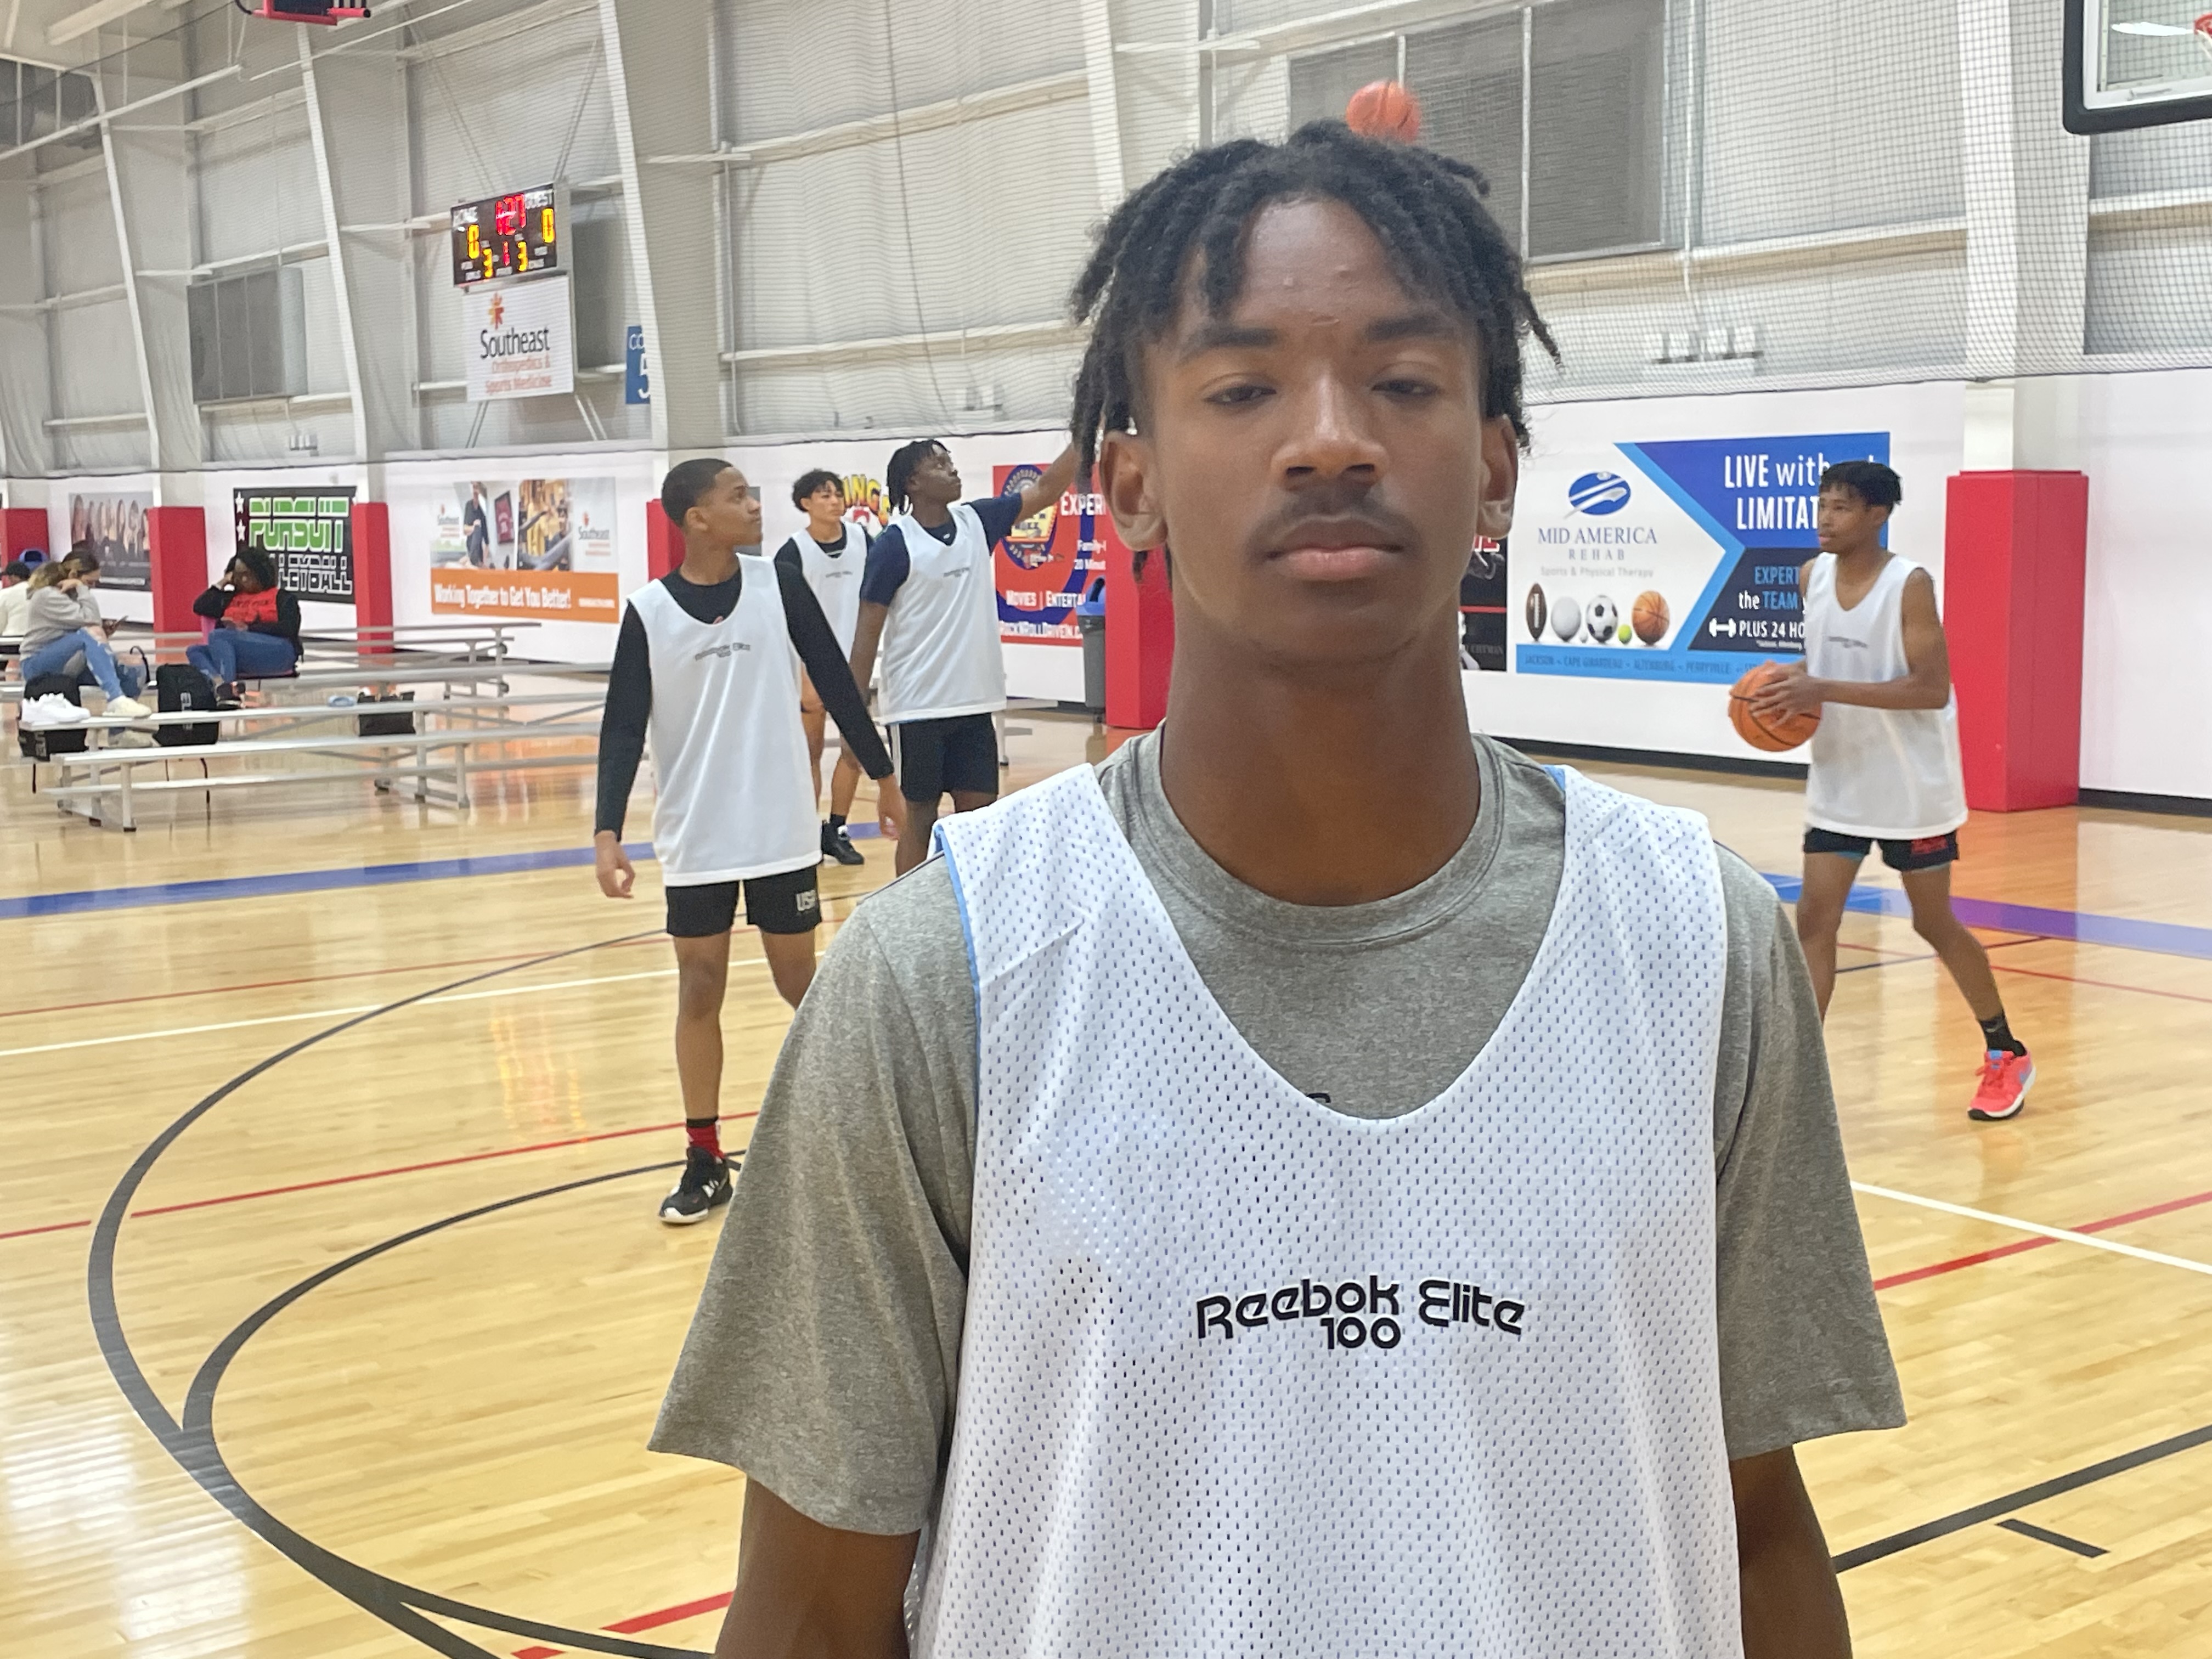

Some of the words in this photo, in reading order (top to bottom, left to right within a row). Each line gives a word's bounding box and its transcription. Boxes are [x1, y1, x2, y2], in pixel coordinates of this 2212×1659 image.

[480, 328, 550, 359] Southeast
[1724, 454, 1769, 488] LIVE
[1736, 495, 1820, 530] LIMITAT
[1538, 527, 1571, 545] MID
[1575, 526, 1657, 545] AMERICA
[1568, 548, 1625, 561] REHAB
[1754, 566, 1801, 585] EXPERT
[1739, 590, 1760, 610] the
[1763, 590, 1798, 611] TEAM
[1738, 620, 1768, 638] PLUS
[1771, 621, 1786, 639] 24
[1789, 621, 1805, 639] HO
[1197, 1274, 1400, 1340] Reebok
[1418, 1278, 1525, 1336] Elite
[1320, 1316, 1402, 1350] 100
